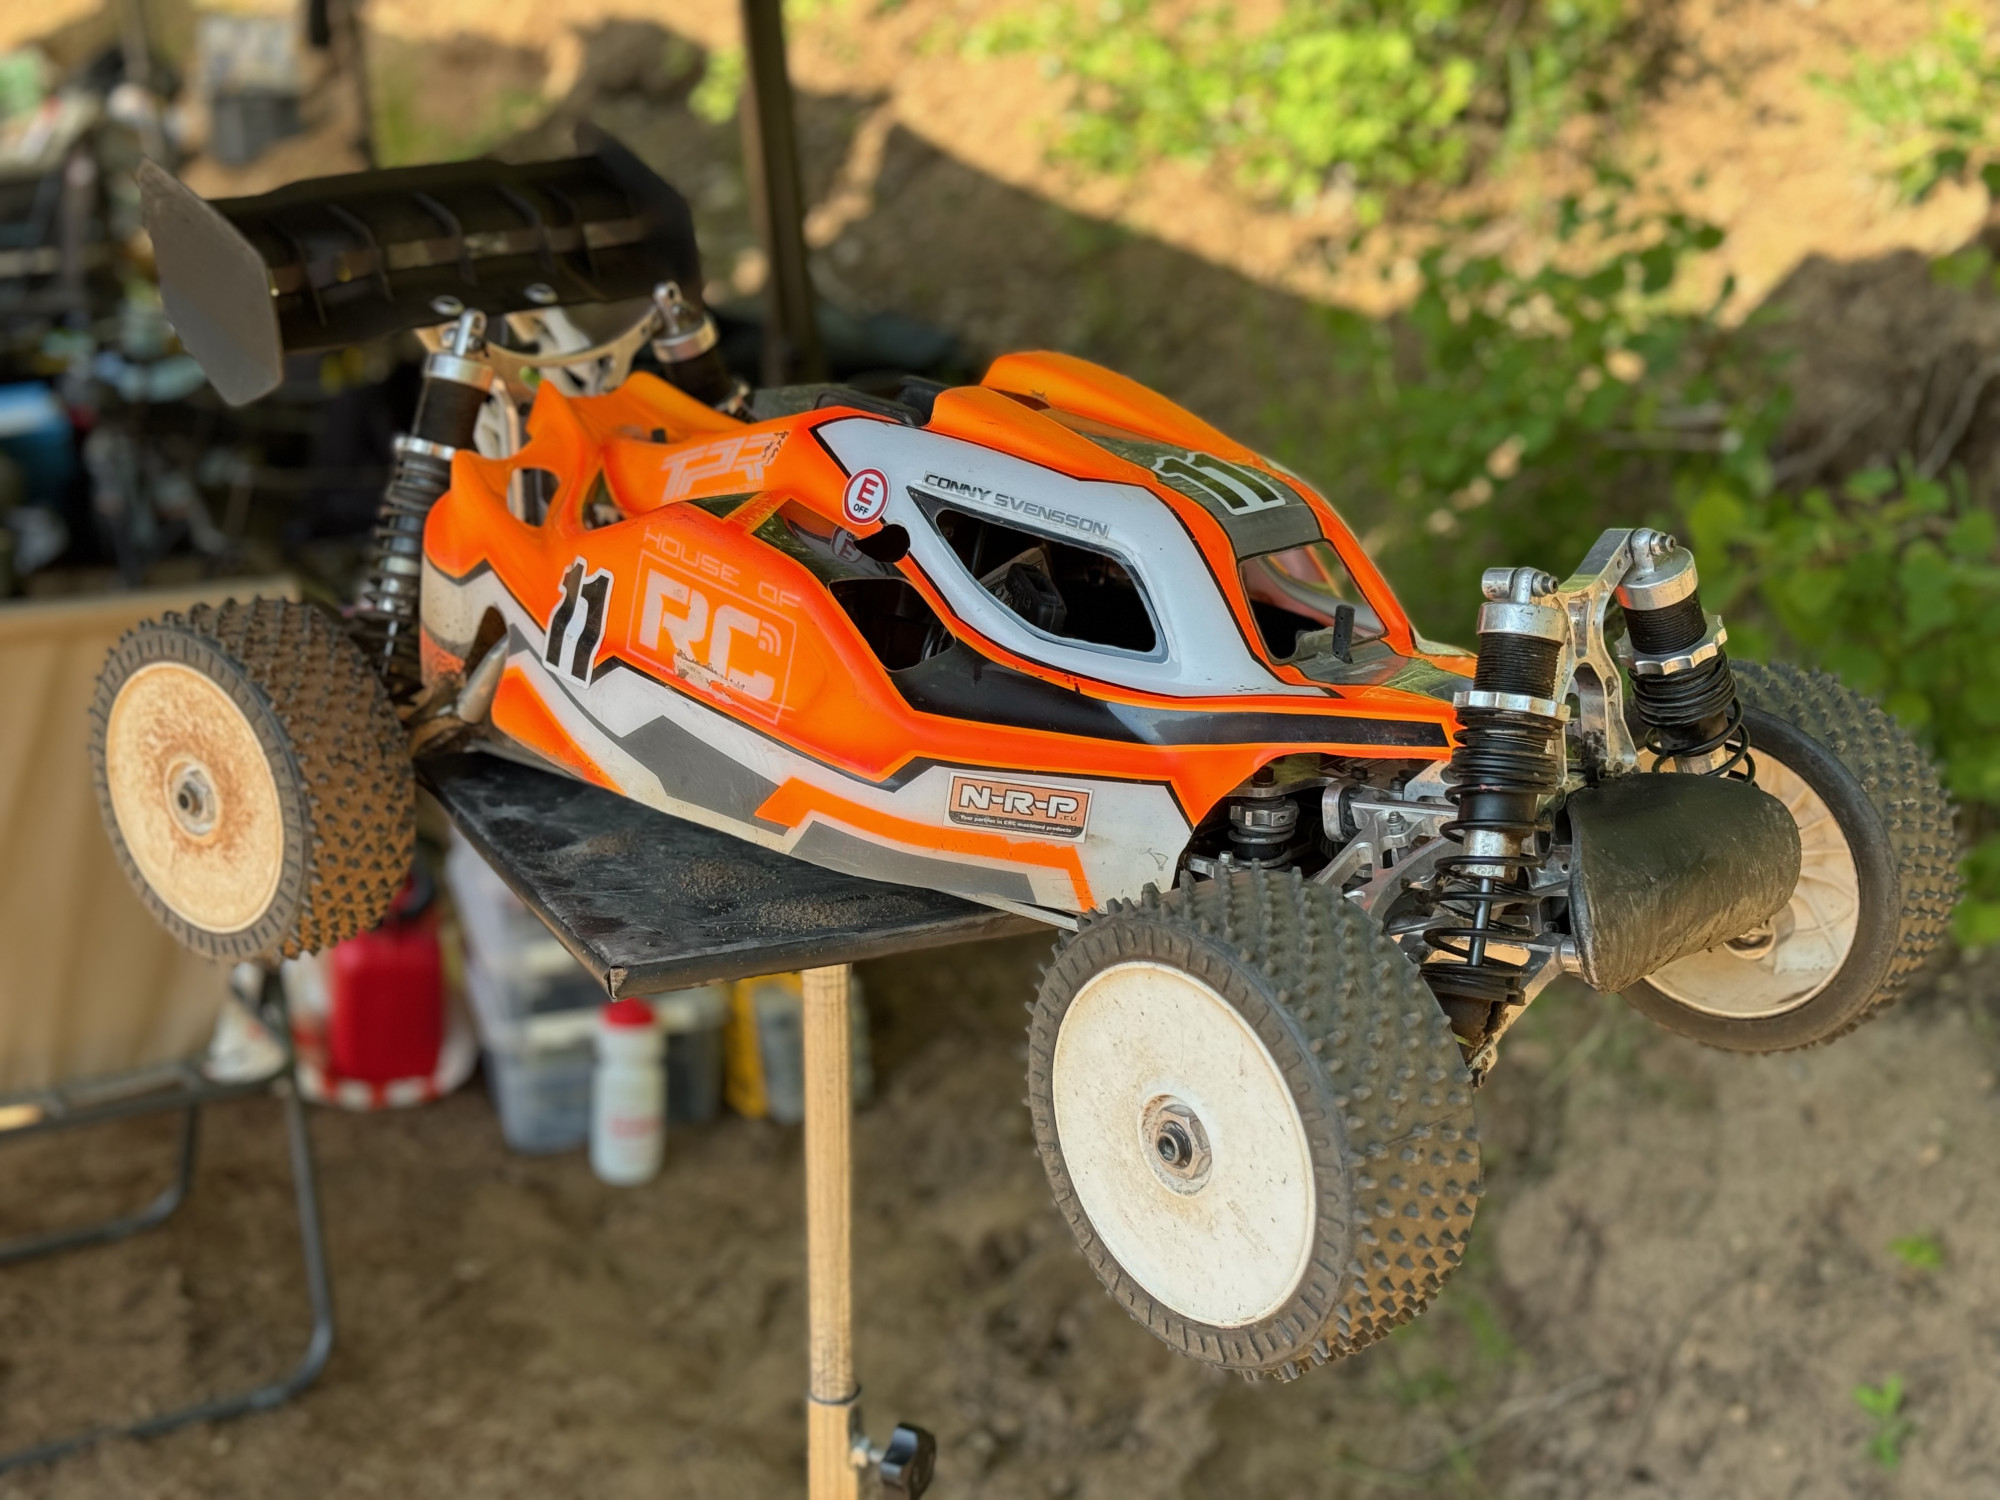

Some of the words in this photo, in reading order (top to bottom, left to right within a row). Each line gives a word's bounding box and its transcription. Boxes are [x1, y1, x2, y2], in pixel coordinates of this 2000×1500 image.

[853, 503, 870, 515] OFF
[857, 477, 879, 506] E
[924, 473, 991, 501] CONNY
[994, 493, 1110, 537] SVENSSON
[1151, 452, 1286, 515] 11
[643, 525, 741, 586] HOUSE
[757, 581, 801, 608] OF
[542, 555, 614, 689] 11
[638, 568, 776, 702] RC
[958, 783, 1079, 818] N-R-P
[1046, 824, 1072, 833] products
